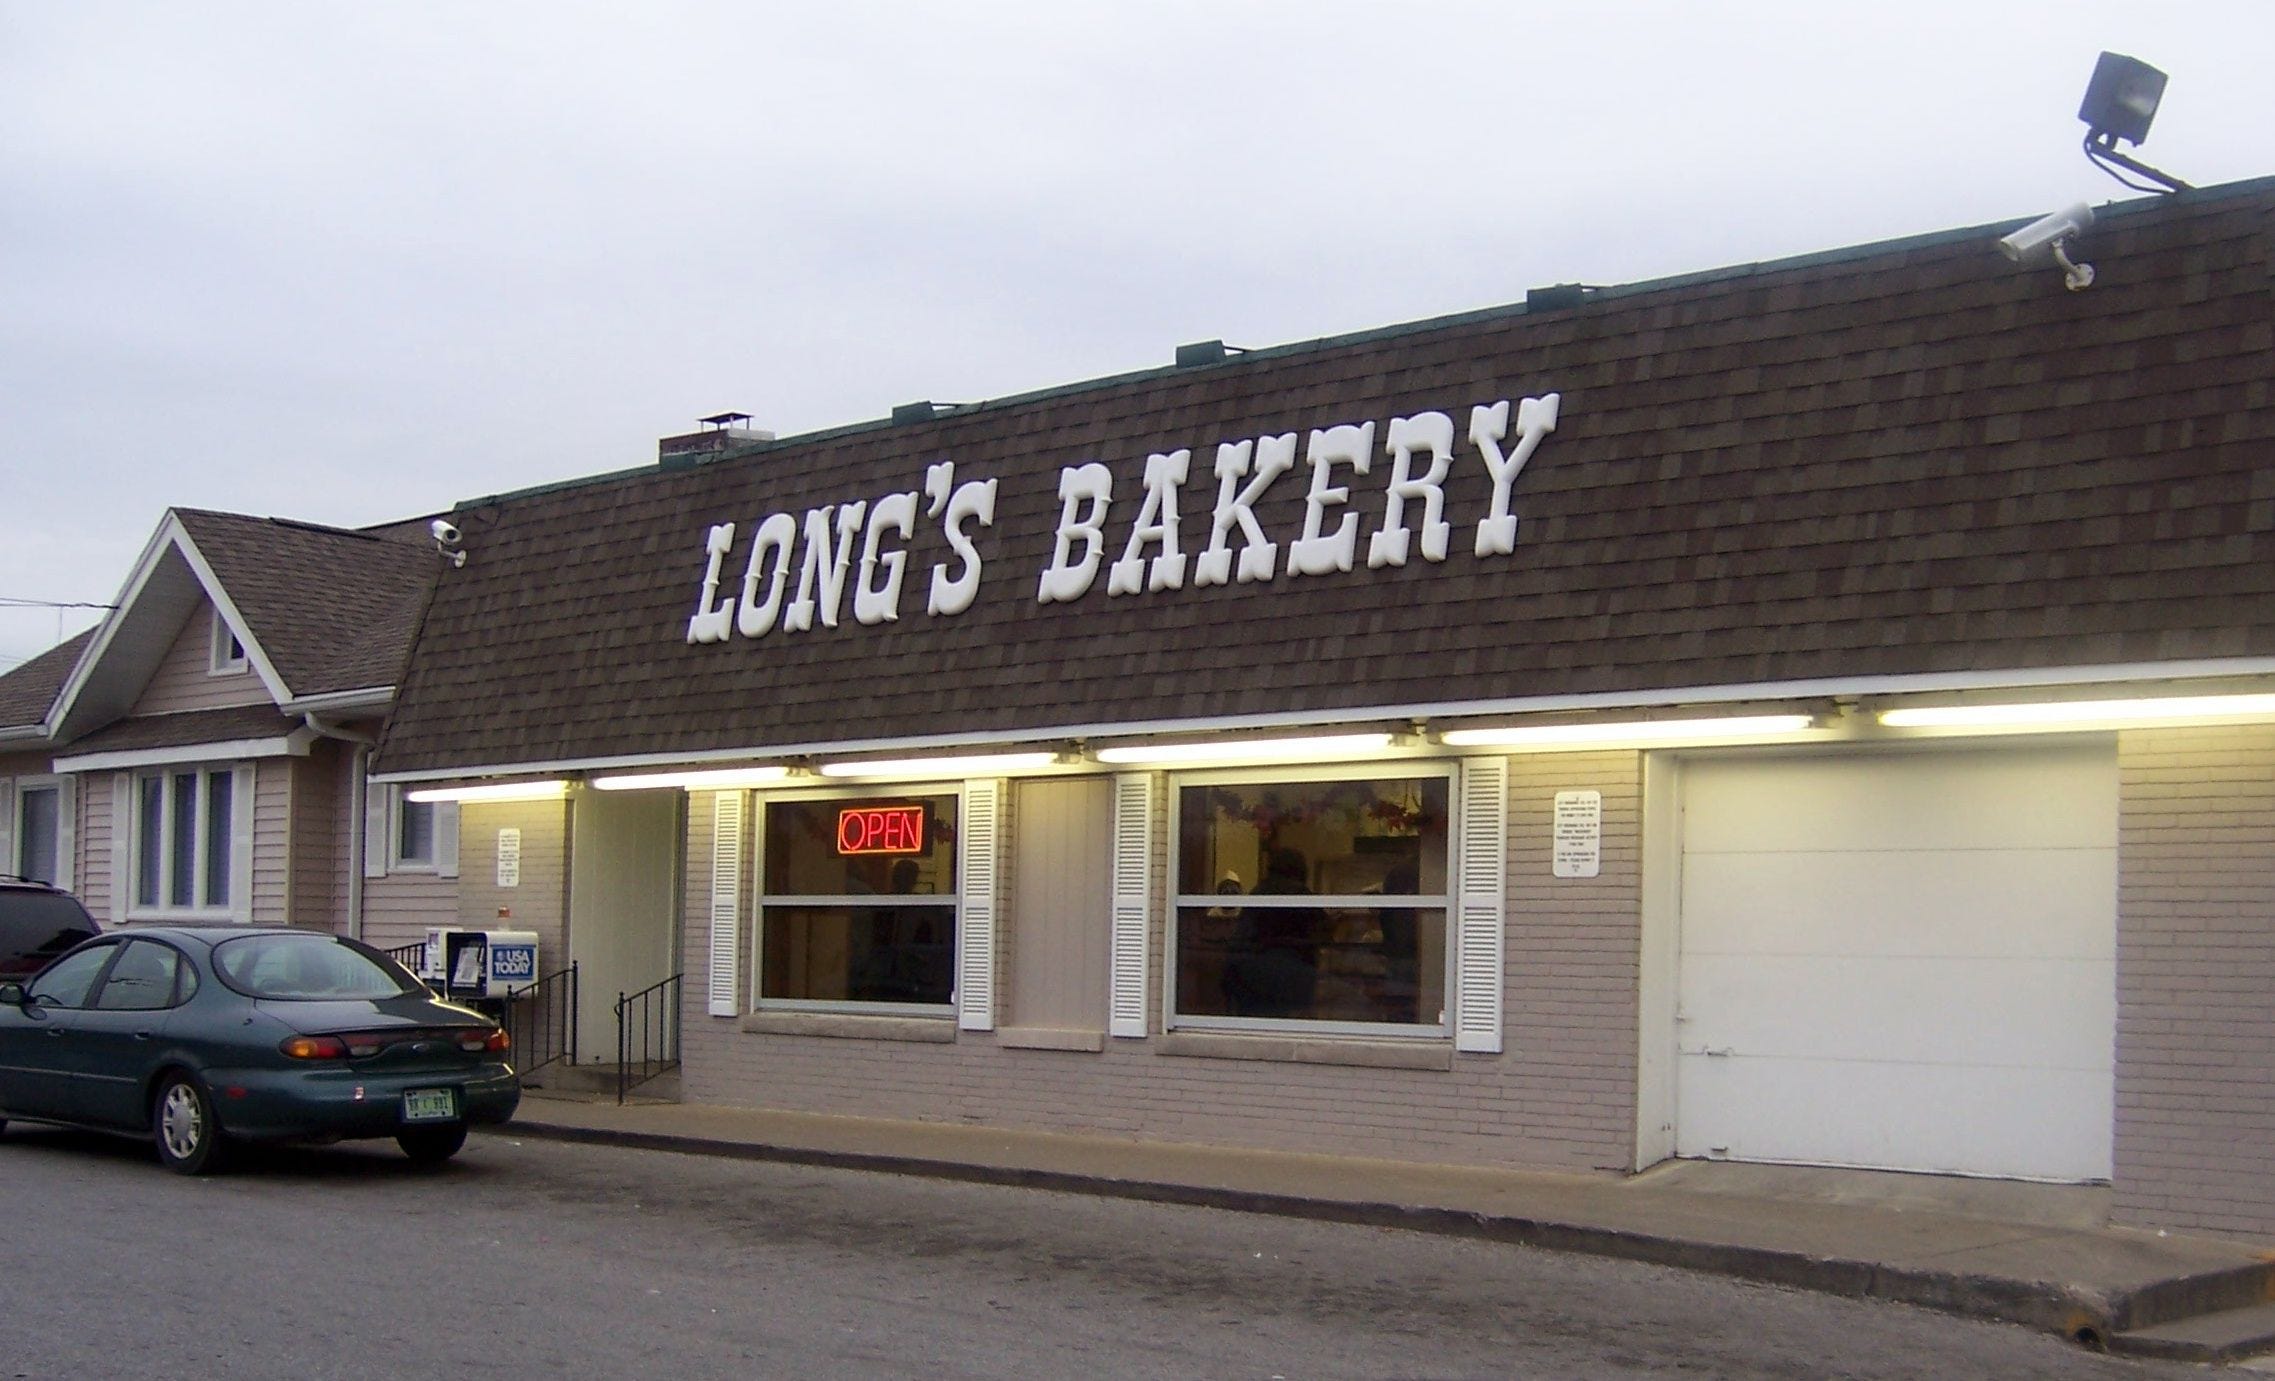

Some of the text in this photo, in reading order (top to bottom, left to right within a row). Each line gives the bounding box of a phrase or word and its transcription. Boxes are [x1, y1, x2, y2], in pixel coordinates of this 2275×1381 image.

[686, 392, 1560, 643] LONG'S BAKERY
[841, 812, 922, 850] OPEN
[494, 961, 531, 974] TODAY
[507, 949, 529, 962] USA
